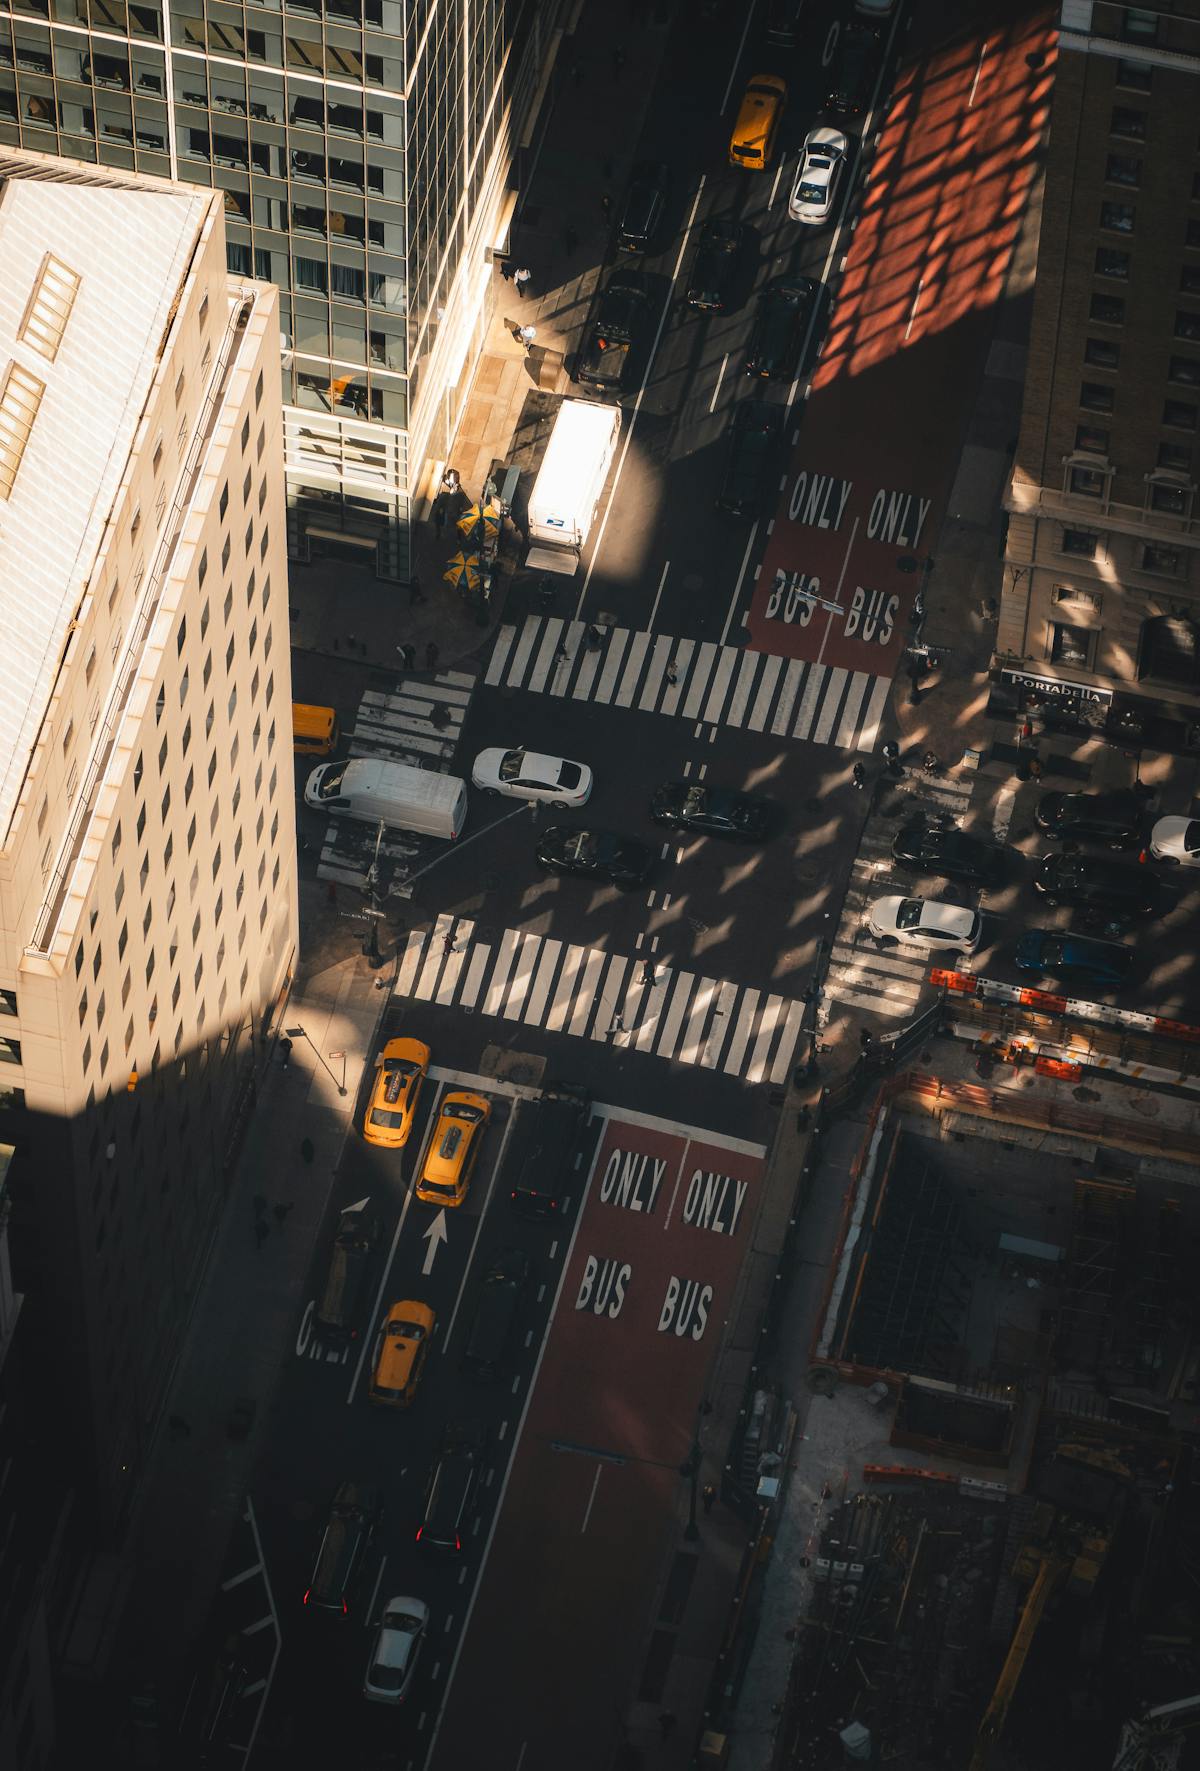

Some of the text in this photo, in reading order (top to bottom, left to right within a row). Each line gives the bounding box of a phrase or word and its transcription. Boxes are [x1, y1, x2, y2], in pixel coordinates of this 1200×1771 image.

[788, 471, 853, 531] ONLY
[866, 489, 932, 549] ONLY
[765, 568, 820, 627] BUS
[844, 586, 900, 646] BUS
[600, 1149, 667, 1214] ONLY
[682, 1169, 748, 1236] ONLY
[575, 1255, 632, 1319] BUS
[657, 1276, 713, 1341] BUS
